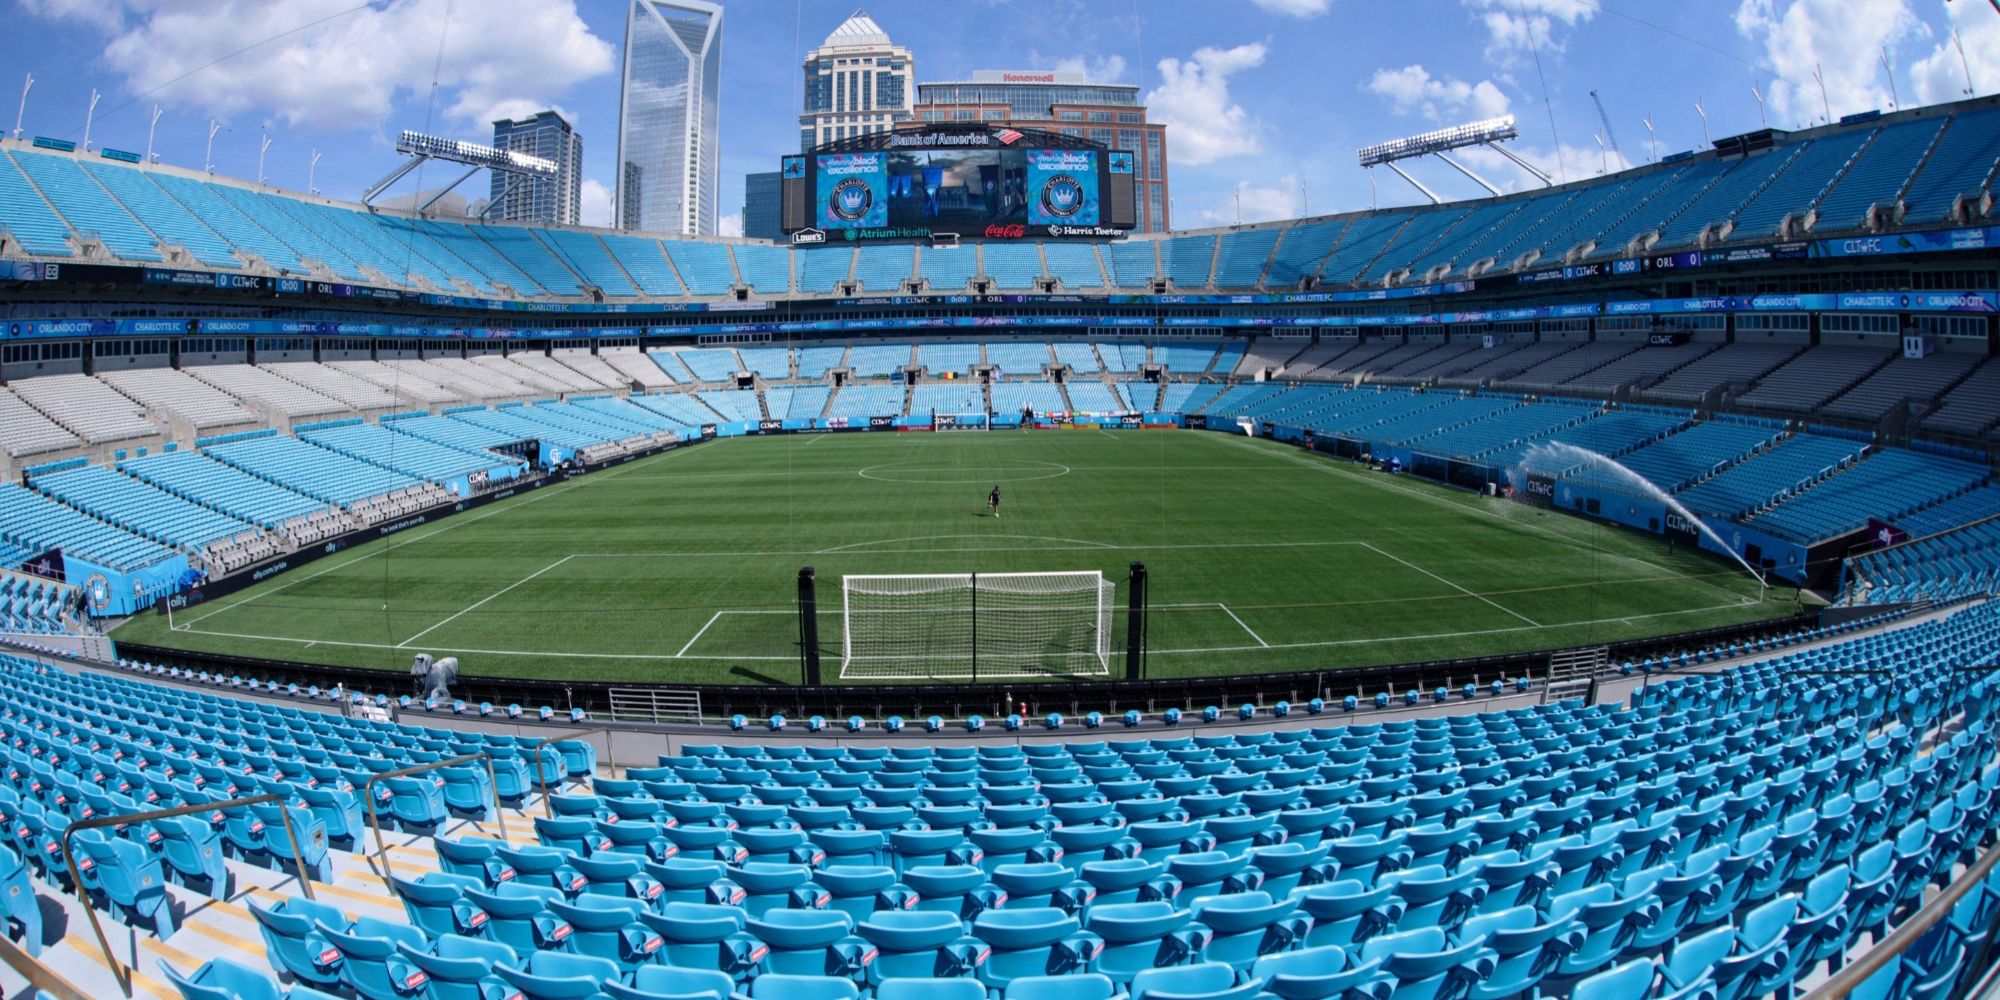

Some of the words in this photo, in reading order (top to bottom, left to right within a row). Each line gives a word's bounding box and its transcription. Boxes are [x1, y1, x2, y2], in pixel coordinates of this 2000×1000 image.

[1004, 74, 1054, 82] Honeywell
[892, 133, 923, 145] Bank
[924, 133, 937, 145] of
[938, 132, 988, 144] America
[854, 156, 878, 164] black
[1064, 154, 1088, 163] black
[828, 164, 878, 175] excellence
[1038, 162, 1088, 171] excellence
[836, 178, 869, 192] CHARLOTTE
[1048, 176, 1080, 189] CHARLOTTE
[859, 229, 896, 238] Atrium
[897, 227, 930, 237] Health
[1064, 227, 1092, 235] Harris
[1094, 227, 1122, 236] Teeter
[796, 234, 822, 242] LOWE'S
[1619, 262, 1635, 272] 0:00
[1657, 257, 1674, 268] ORL
[1690, 254, 1696, 264] 0
[1567, 268, 1572, 278] 0
[221, 275, 226, 285] 0
[282, 278, 298, 291] 0:00
[318, 283, 333, 294] ORL
[345, 286, 351, 295] 0
[1684, 301, 1716, 309] CHARLOTTE
[1717, 300, 1725, 308] FC
[1753, 298, 1785, 306] ORLANDO
[1786, 298, 1801, 306] CITY
[1844, 297, 1884, 306] CHARLOTTE
[1885, 297, 1895, 306] FC
[1929, 297, 1966, 306] ORLANDO
[1967, 297, 1984, 306] CITY
[528, 303, 558, 312] CHARLOTTE
[1639, 303, 1651, 311] CITY
[38, 324, 76, 334] ORLANDO
[76, 323, 92, 332] CITY
[135, 323, 172, 331] CHARLOTTE
[172, 322, 180, 331] FC
[325, 543, 336, 553] ally
[254, 561, 287, 580] ally.com/pride
[170, 595, 187, 608] ally
